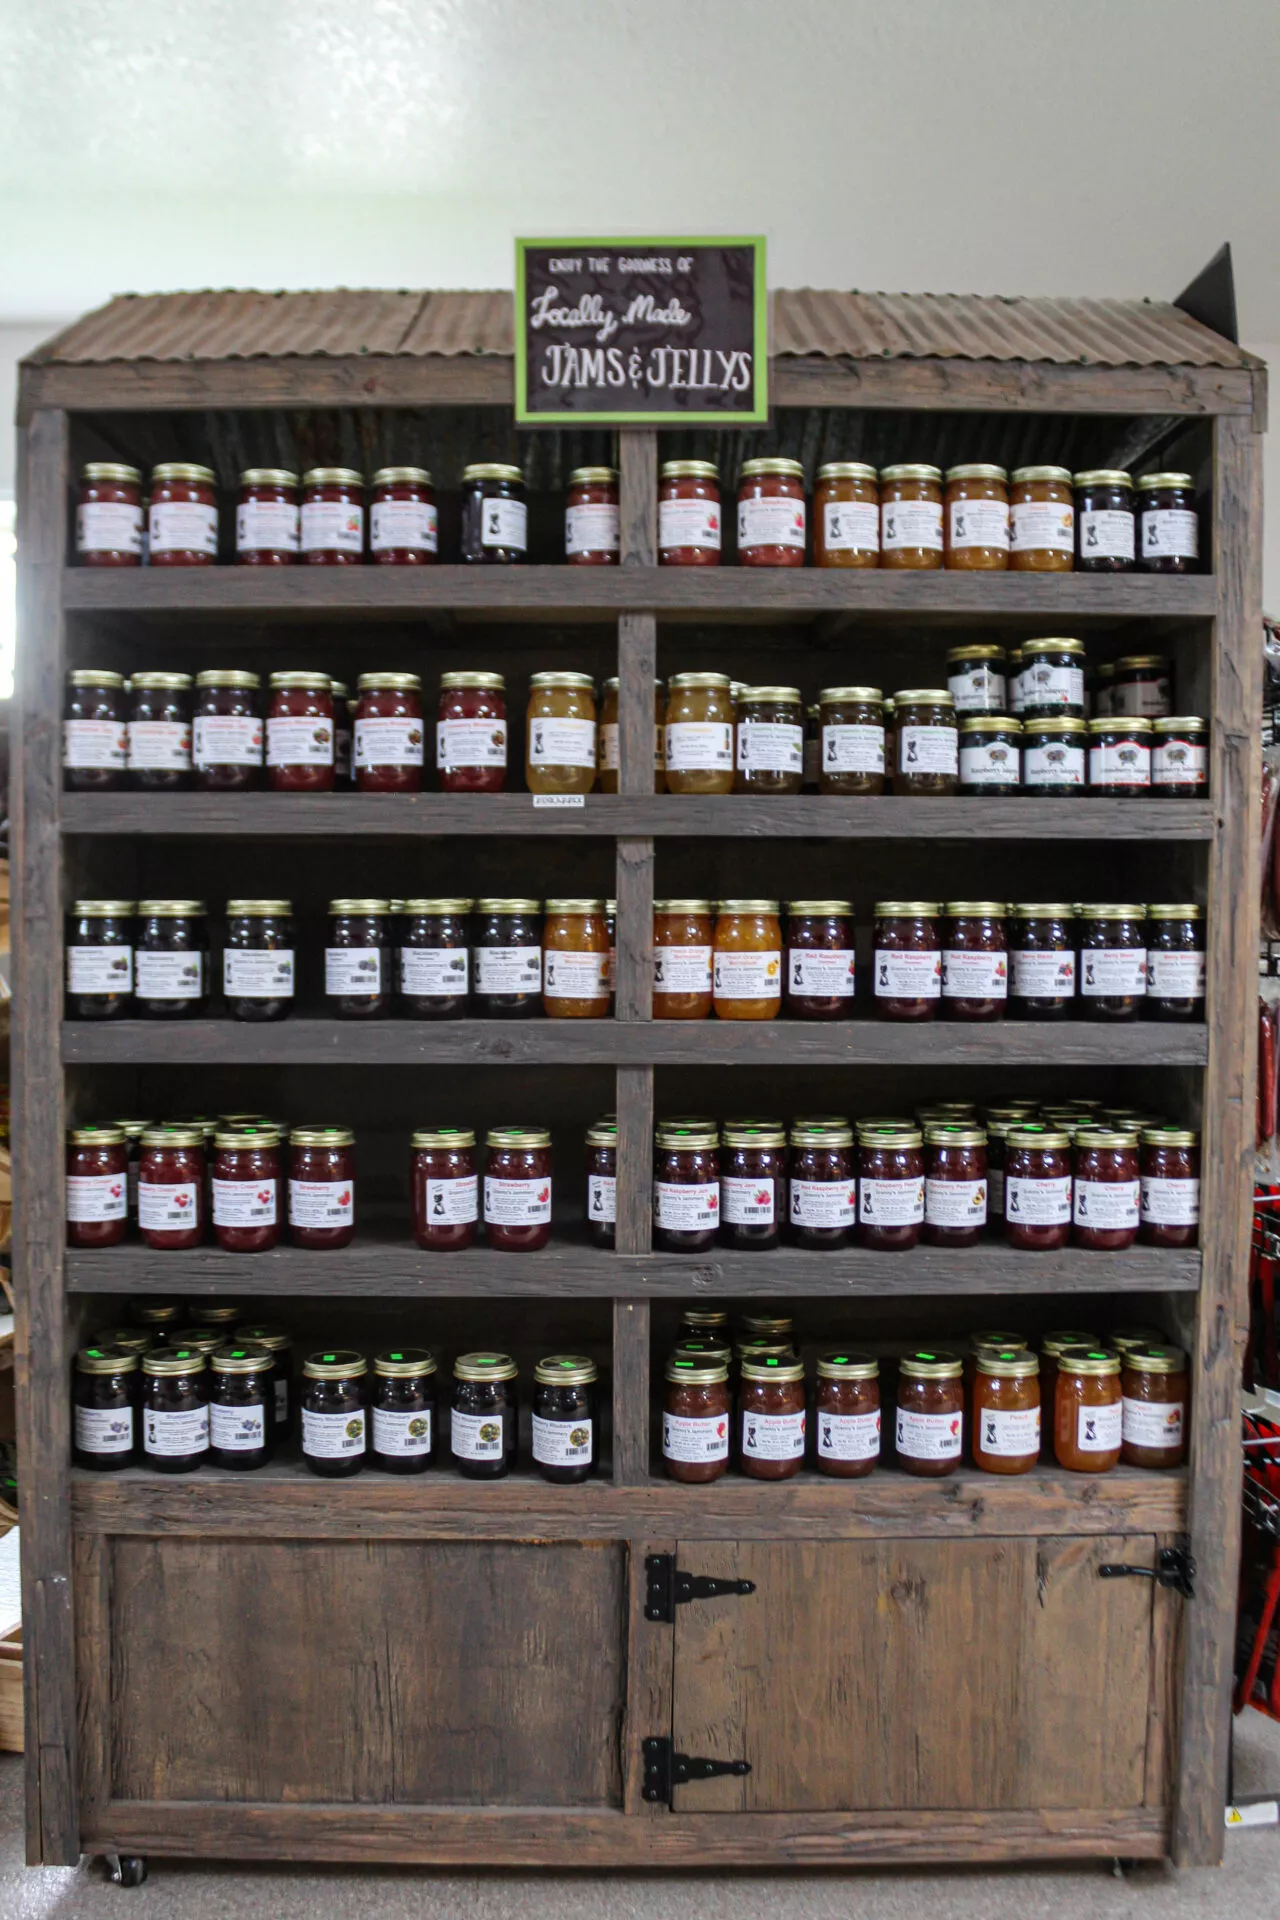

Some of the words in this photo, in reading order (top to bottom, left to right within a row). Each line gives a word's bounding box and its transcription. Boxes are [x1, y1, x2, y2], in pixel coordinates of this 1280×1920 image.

[588, 257, 610, 273] THE
[617, 257, 673, 273] GOODNESS
[676, 257, 694, 272] OF
[530, 285, 619, 342] Locally
[621, 294, 692, 325] Made
[541, 342, 626, 388] JAMS
[628, 346, 643, 389] &
[646, 344, 752, 391] JELLYS
